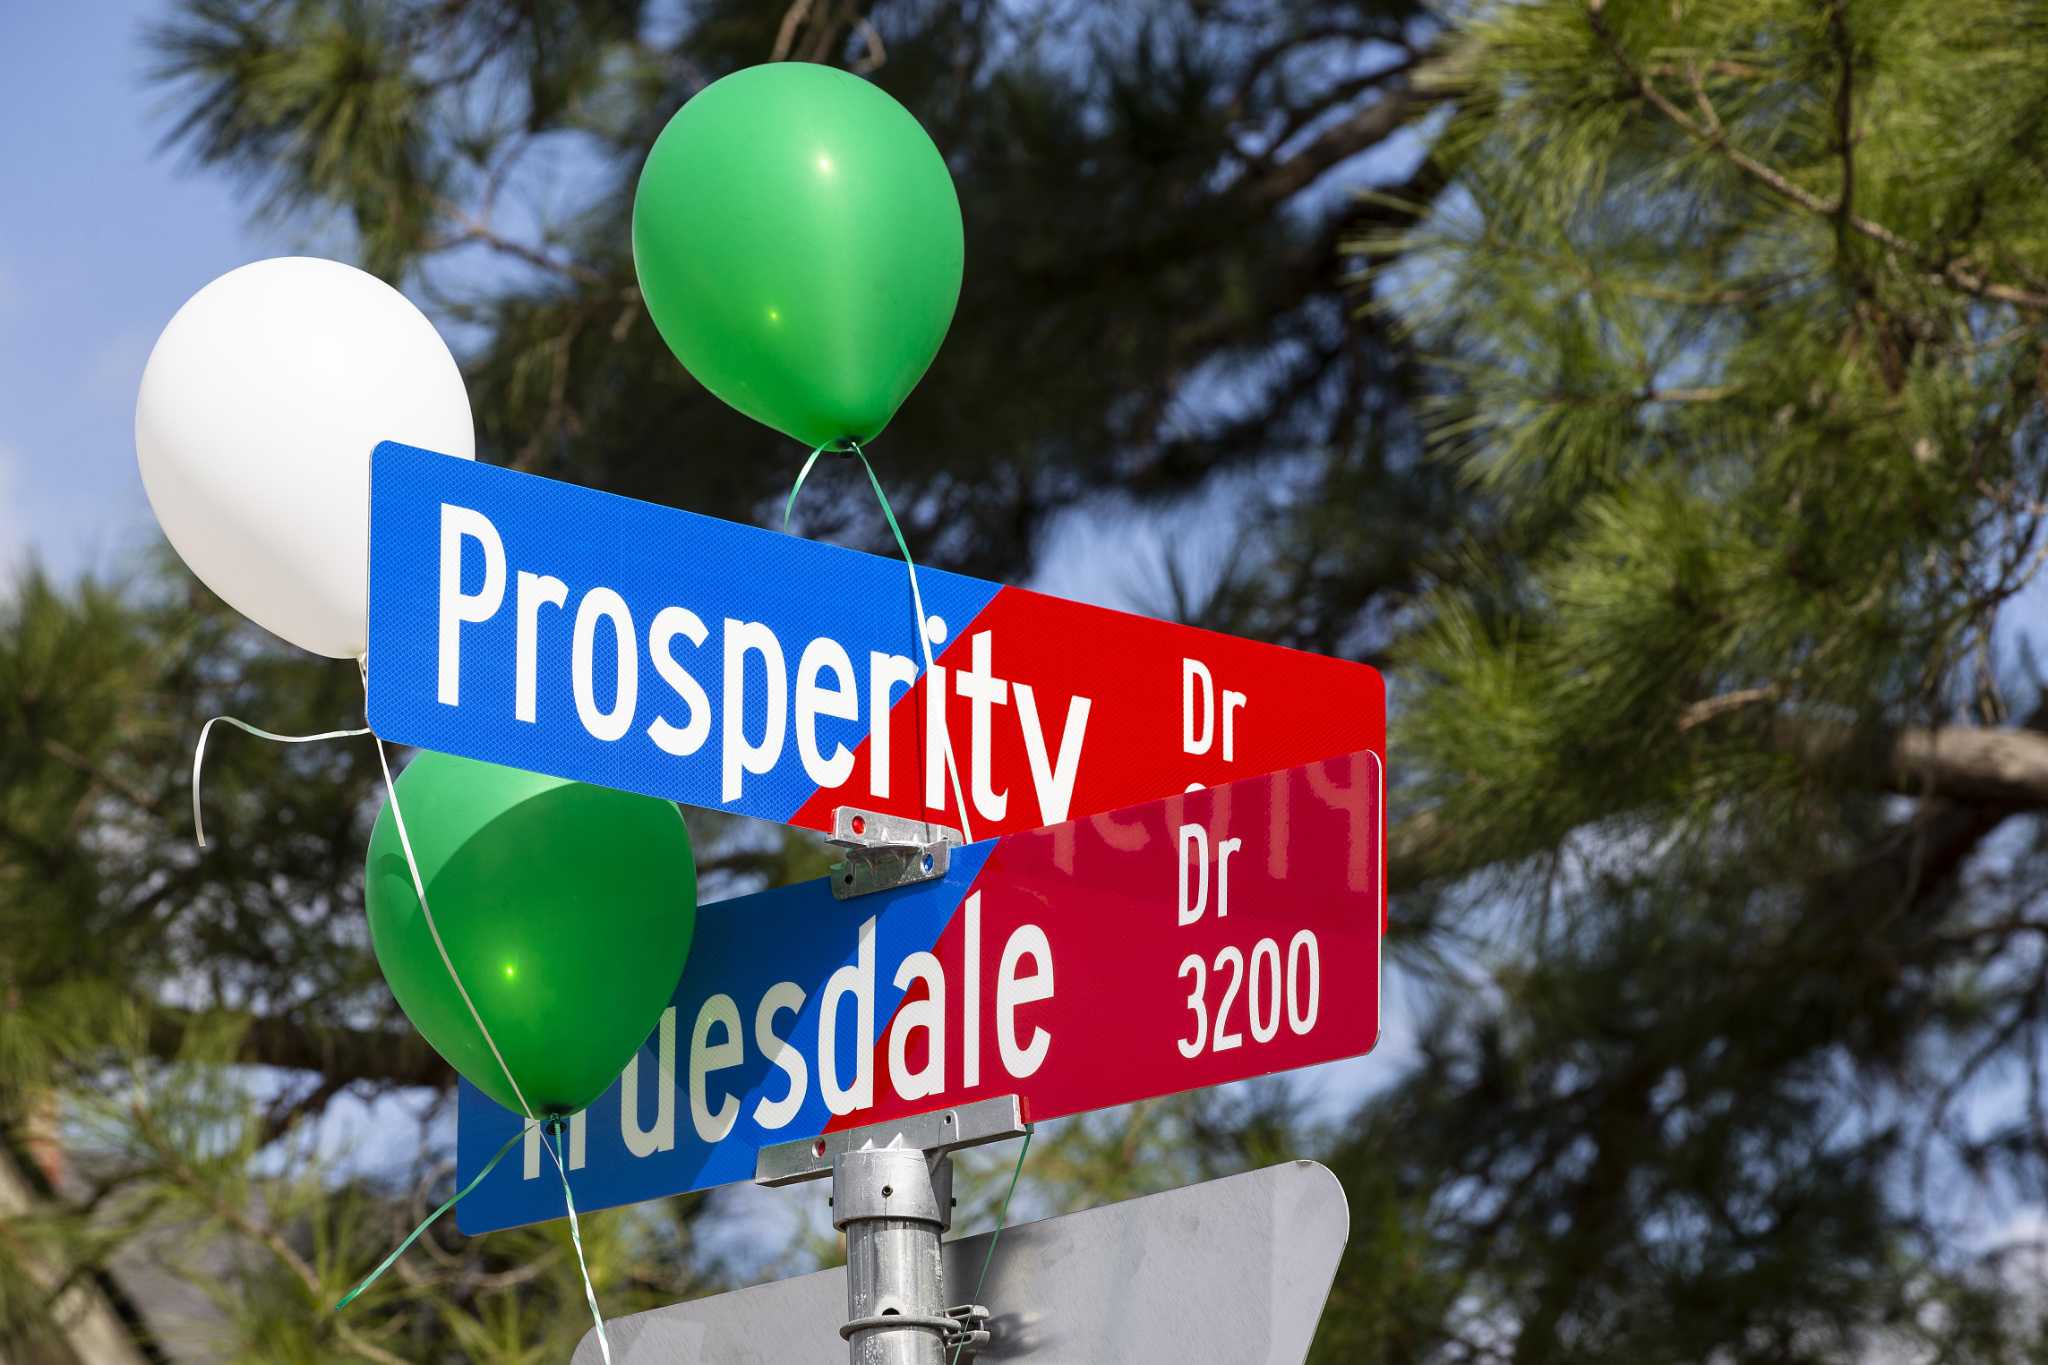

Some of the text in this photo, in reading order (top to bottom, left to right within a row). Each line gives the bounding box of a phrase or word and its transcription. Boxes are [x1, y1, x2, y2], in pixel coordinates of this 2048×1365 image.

[438, 502, 1092, 826] Prosperity
[1183, 658, 1247, 762] Dr
[523, 823, 1242, 1181] uesdale Dr
[1177, 929, 1320, 1059] 3200
